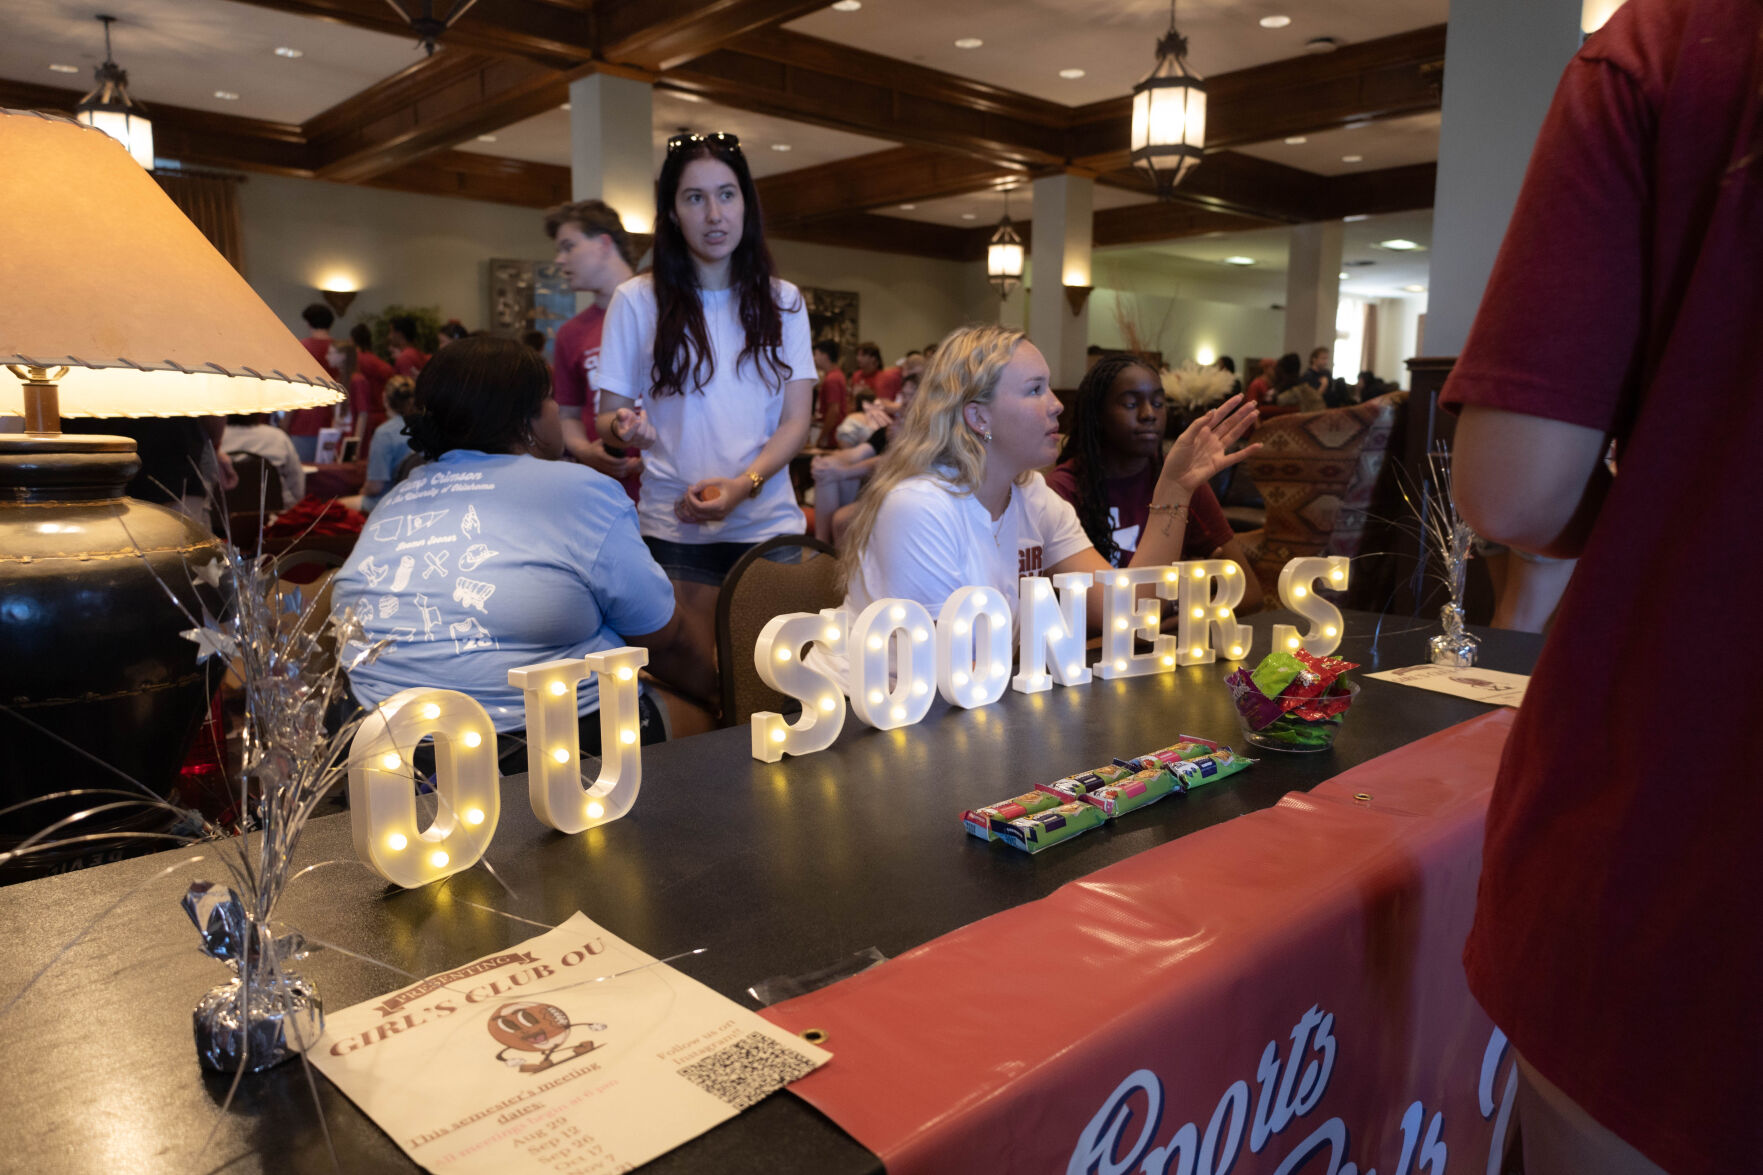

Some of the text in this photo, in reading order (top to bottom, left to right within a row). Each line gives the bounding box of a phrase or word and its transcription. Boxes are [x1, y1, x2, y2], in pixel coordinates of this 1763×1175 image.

[348, 647, 649, 889] OU
[329, 937, 607, 1057] GIRL'S CLUB OU
[396, 954, 511, 1004] PRESENTING
[409, 1062, 602, 1148] This semester's meeting
[512, 1127, 548, 1148] Aug
[527, 1137, 561, 1156] Sep
